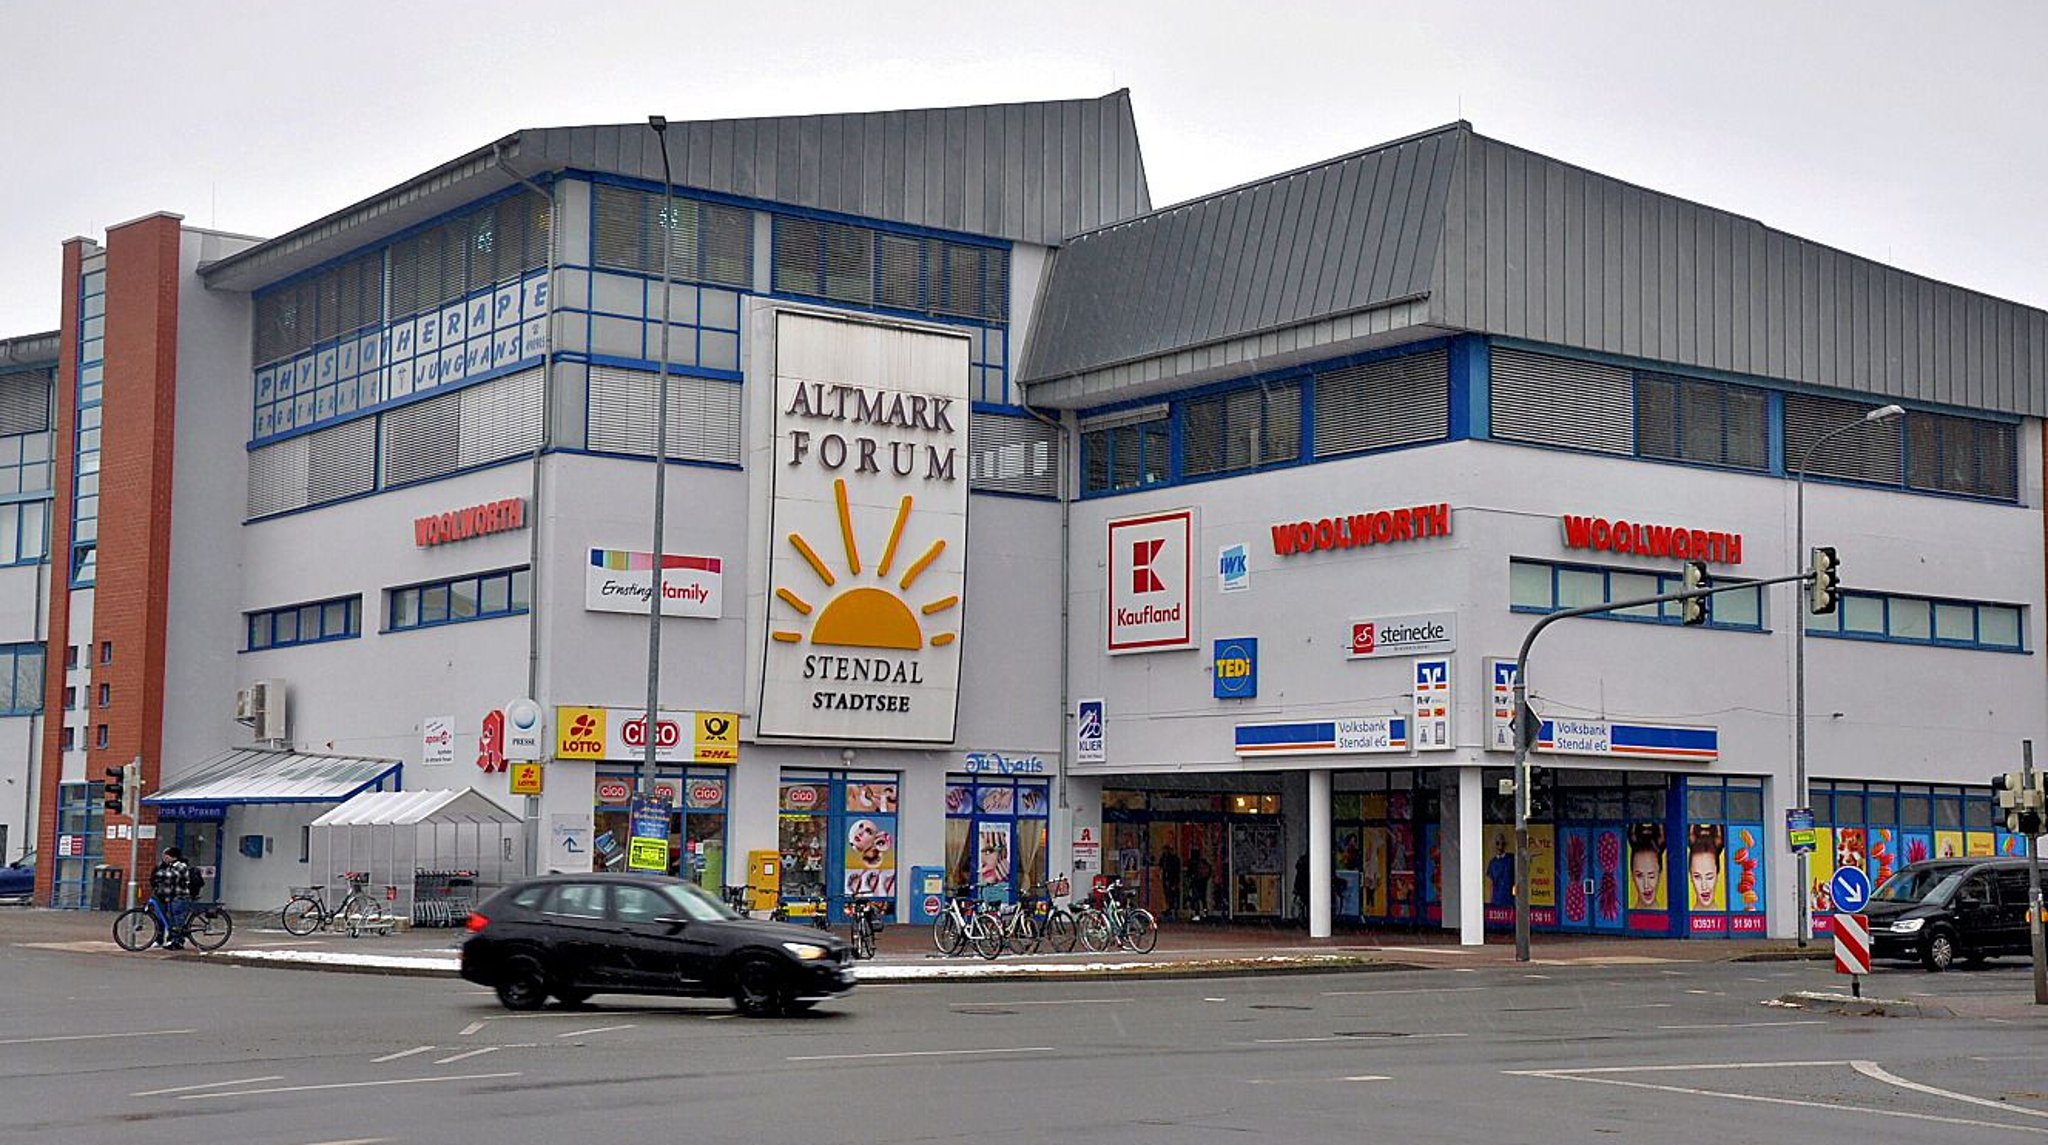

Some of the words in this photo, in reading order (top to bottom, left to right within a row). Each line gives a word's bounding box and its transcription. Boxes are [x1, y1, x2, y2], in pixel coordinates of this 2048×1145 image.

[417, 335, 520, 383] JUNGHANS
[785, 380, 955, 433] ALTMARK
[787, 429, 957, 482] FORUM
[414, 498, 523, 547] WOOLWORTH
[1271, 503, 1451, 556] WOOLWORTH
[1563, 514, 1742, 565] WOOLWORTH
[1220, 554, 1247, 574] IWK
[602, 579, 652, 602] Ernsting
[662, 578, 709, 604] family
[1117, 602, 1181, 626] Kaufland
[1380, 620, 1444, 643] steinecke
[803, 655, 923, 684] STENDAL
[1217, 658, 1250, 678] TEDi
[812, 691, 911, 713] STADTSEE
[1338, 720, 1386, 733] Volksbank
[1558, 721, 1607, 736] Volksbank
[562, 740, 602, 753] LOTTO
[1079, 740, 1102, 751] KLIER
[1339, 736, 1373, 749] Stendal
[1375, 735, 1387, 748] eG
[1558, 738, 1593, 751] Stendal
[1594, 739, 1607, 752] eG
[700, 749, 732, 759] DHL
[517, 780, 539, 788] LOTTO
